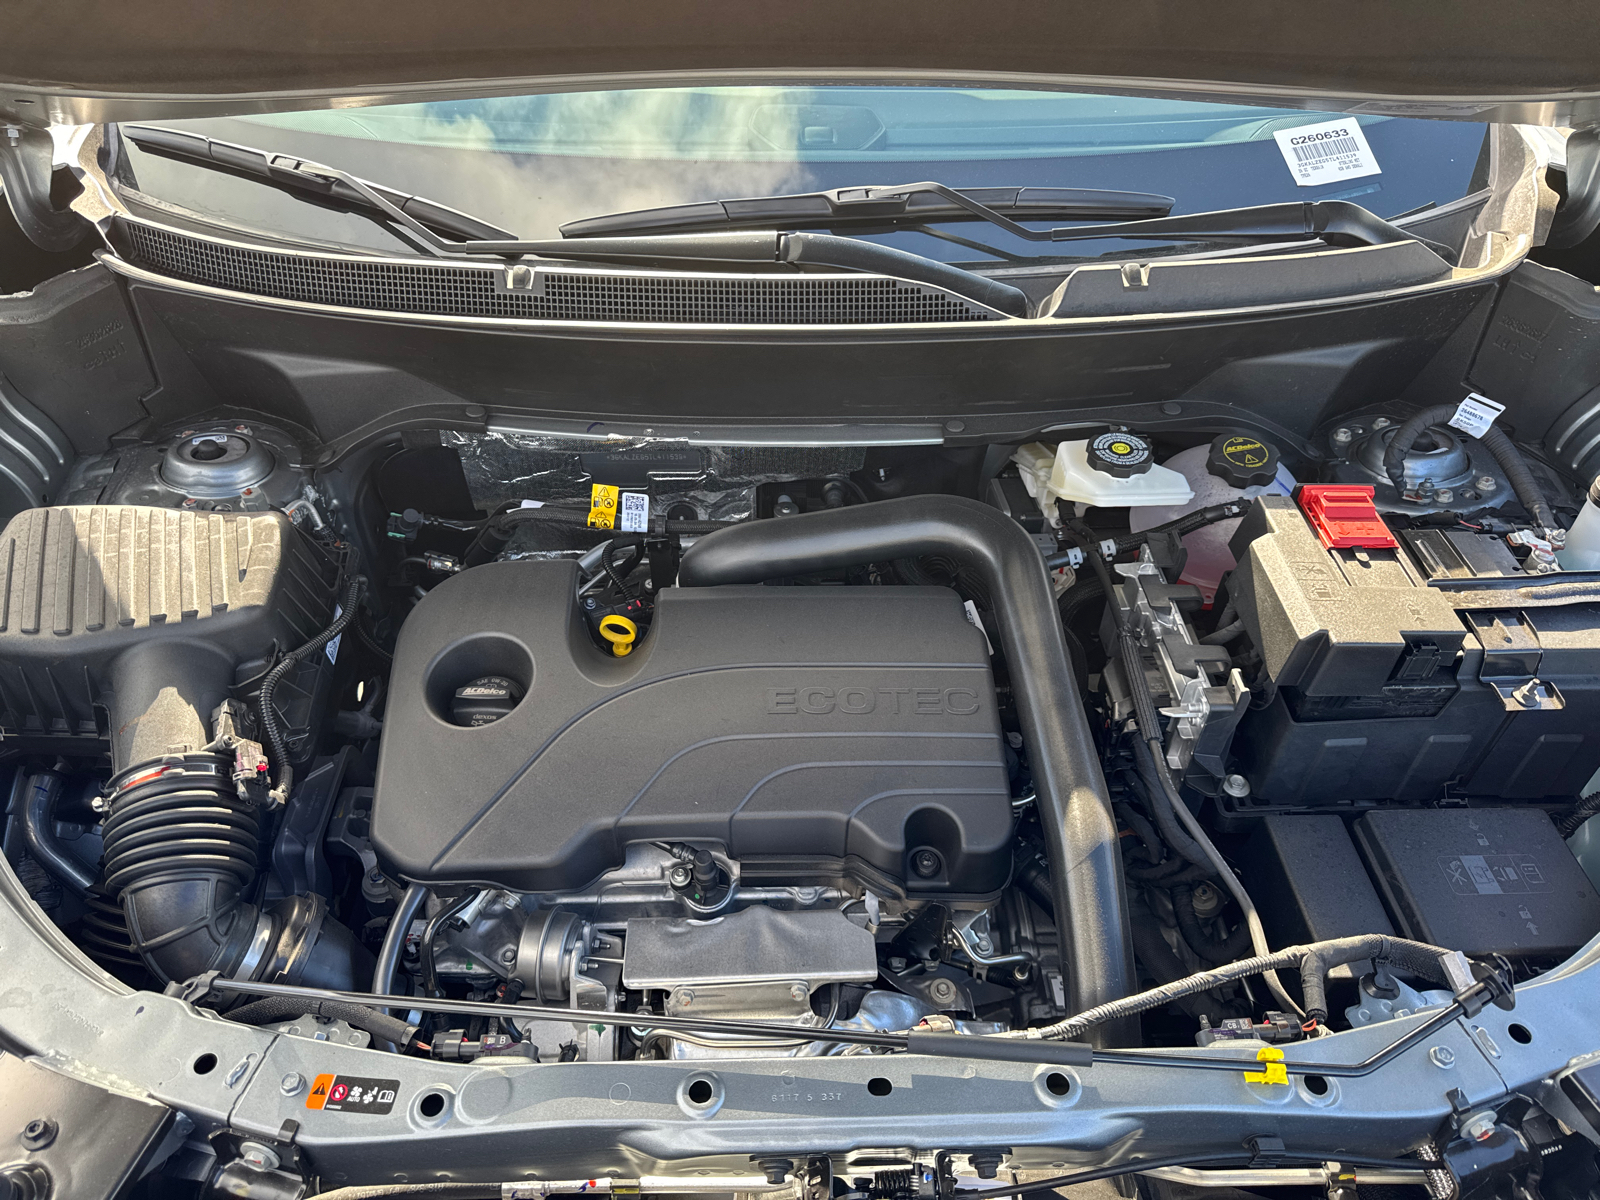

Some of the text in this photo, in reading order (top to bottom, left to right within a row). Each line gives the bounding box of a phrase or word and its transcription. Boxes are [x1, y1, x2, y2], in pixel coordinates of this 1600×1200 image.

[1290, 128, 1349, 145] G260633
[1226, 443, 1261, 452] ACDelco
[461, 687, 506, 695] ACDelco
[766, 686, 980, 715] ECOTEC
[500, 1036, 506, 1044] B
[807, 1093, 813, 1102] 5
